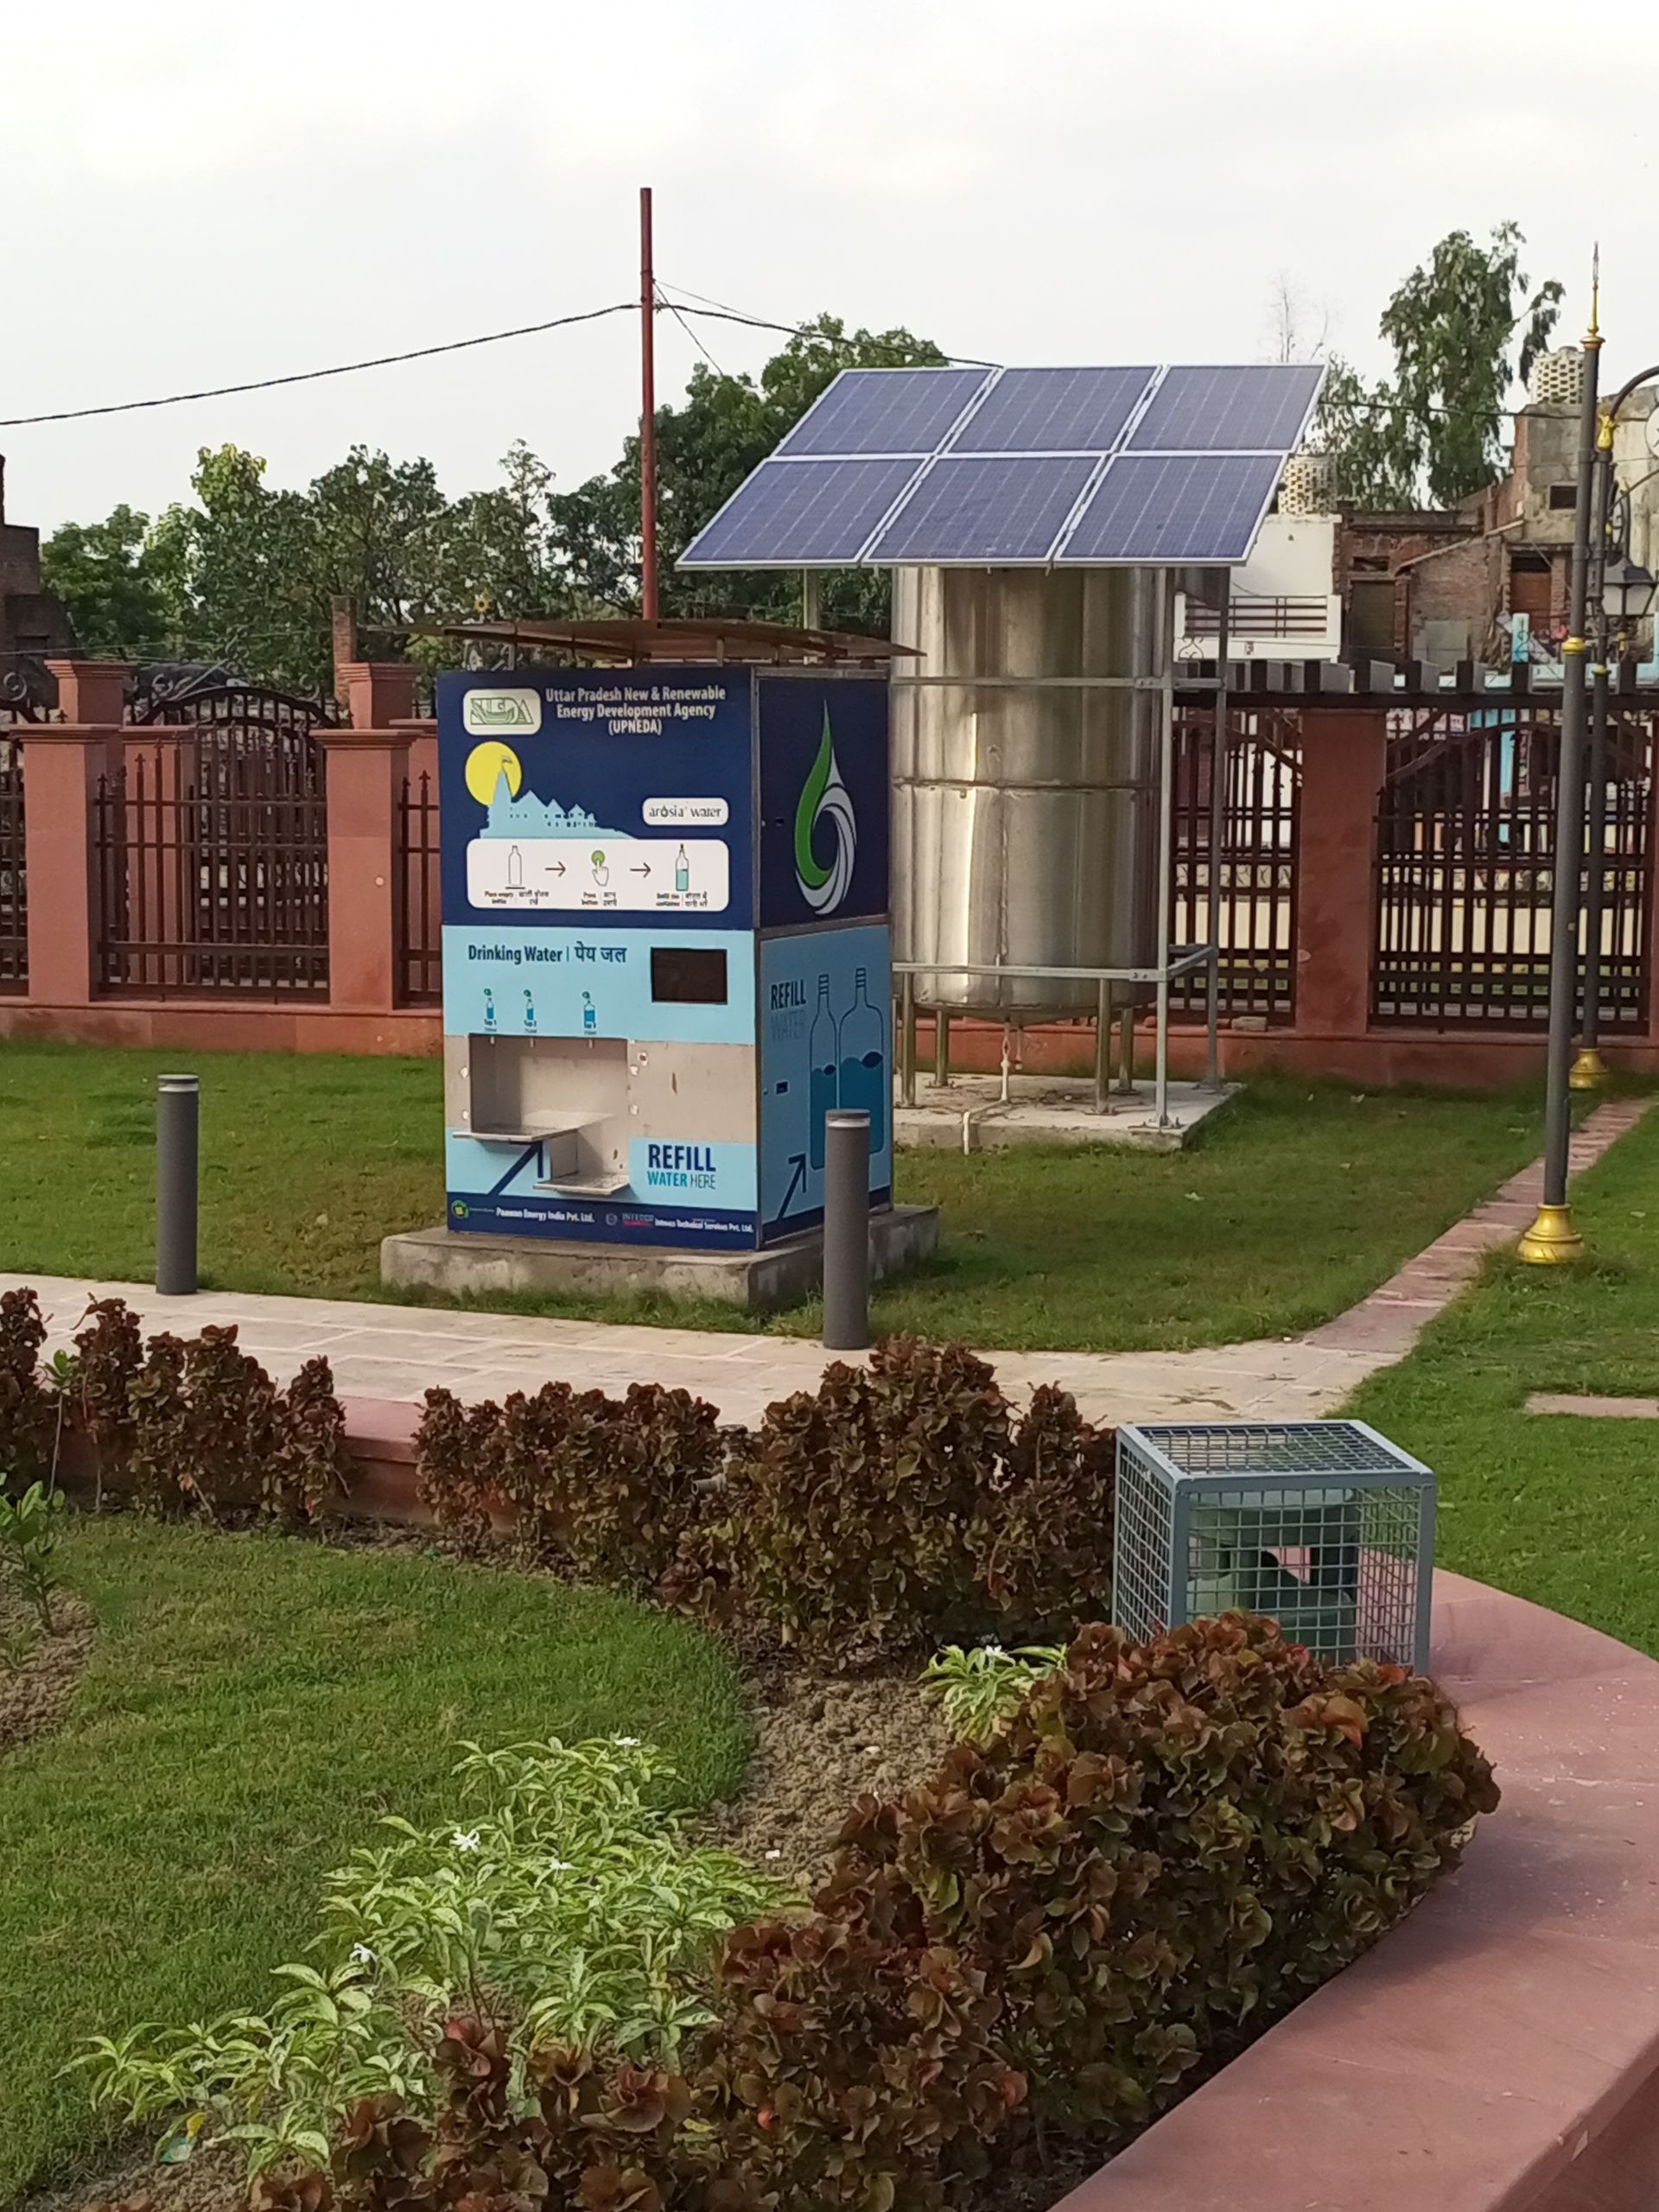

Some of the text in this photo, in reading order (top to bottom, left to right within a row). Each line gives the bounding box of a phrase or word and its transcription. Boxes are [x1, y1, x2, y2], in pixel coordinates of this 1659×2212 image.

[545, 685, 726, 702] Uttar Pradesh New & Renewable
[556, 702, 716, 721] Energy Development Agency
[608, 719, 662, 735] (UPNEDA)
[690, 807, 721, 817] water
[468, 944, 563, 965] Drinking Water
[575, 940, 627, 963] पेय जल
[771, 979, 806, 1010] REFILL
[648, 1144, 716, 1172] REFILL
[647, 1171, 716, 1190] WATER HERE
[548, 1211, 565, 1220] India
